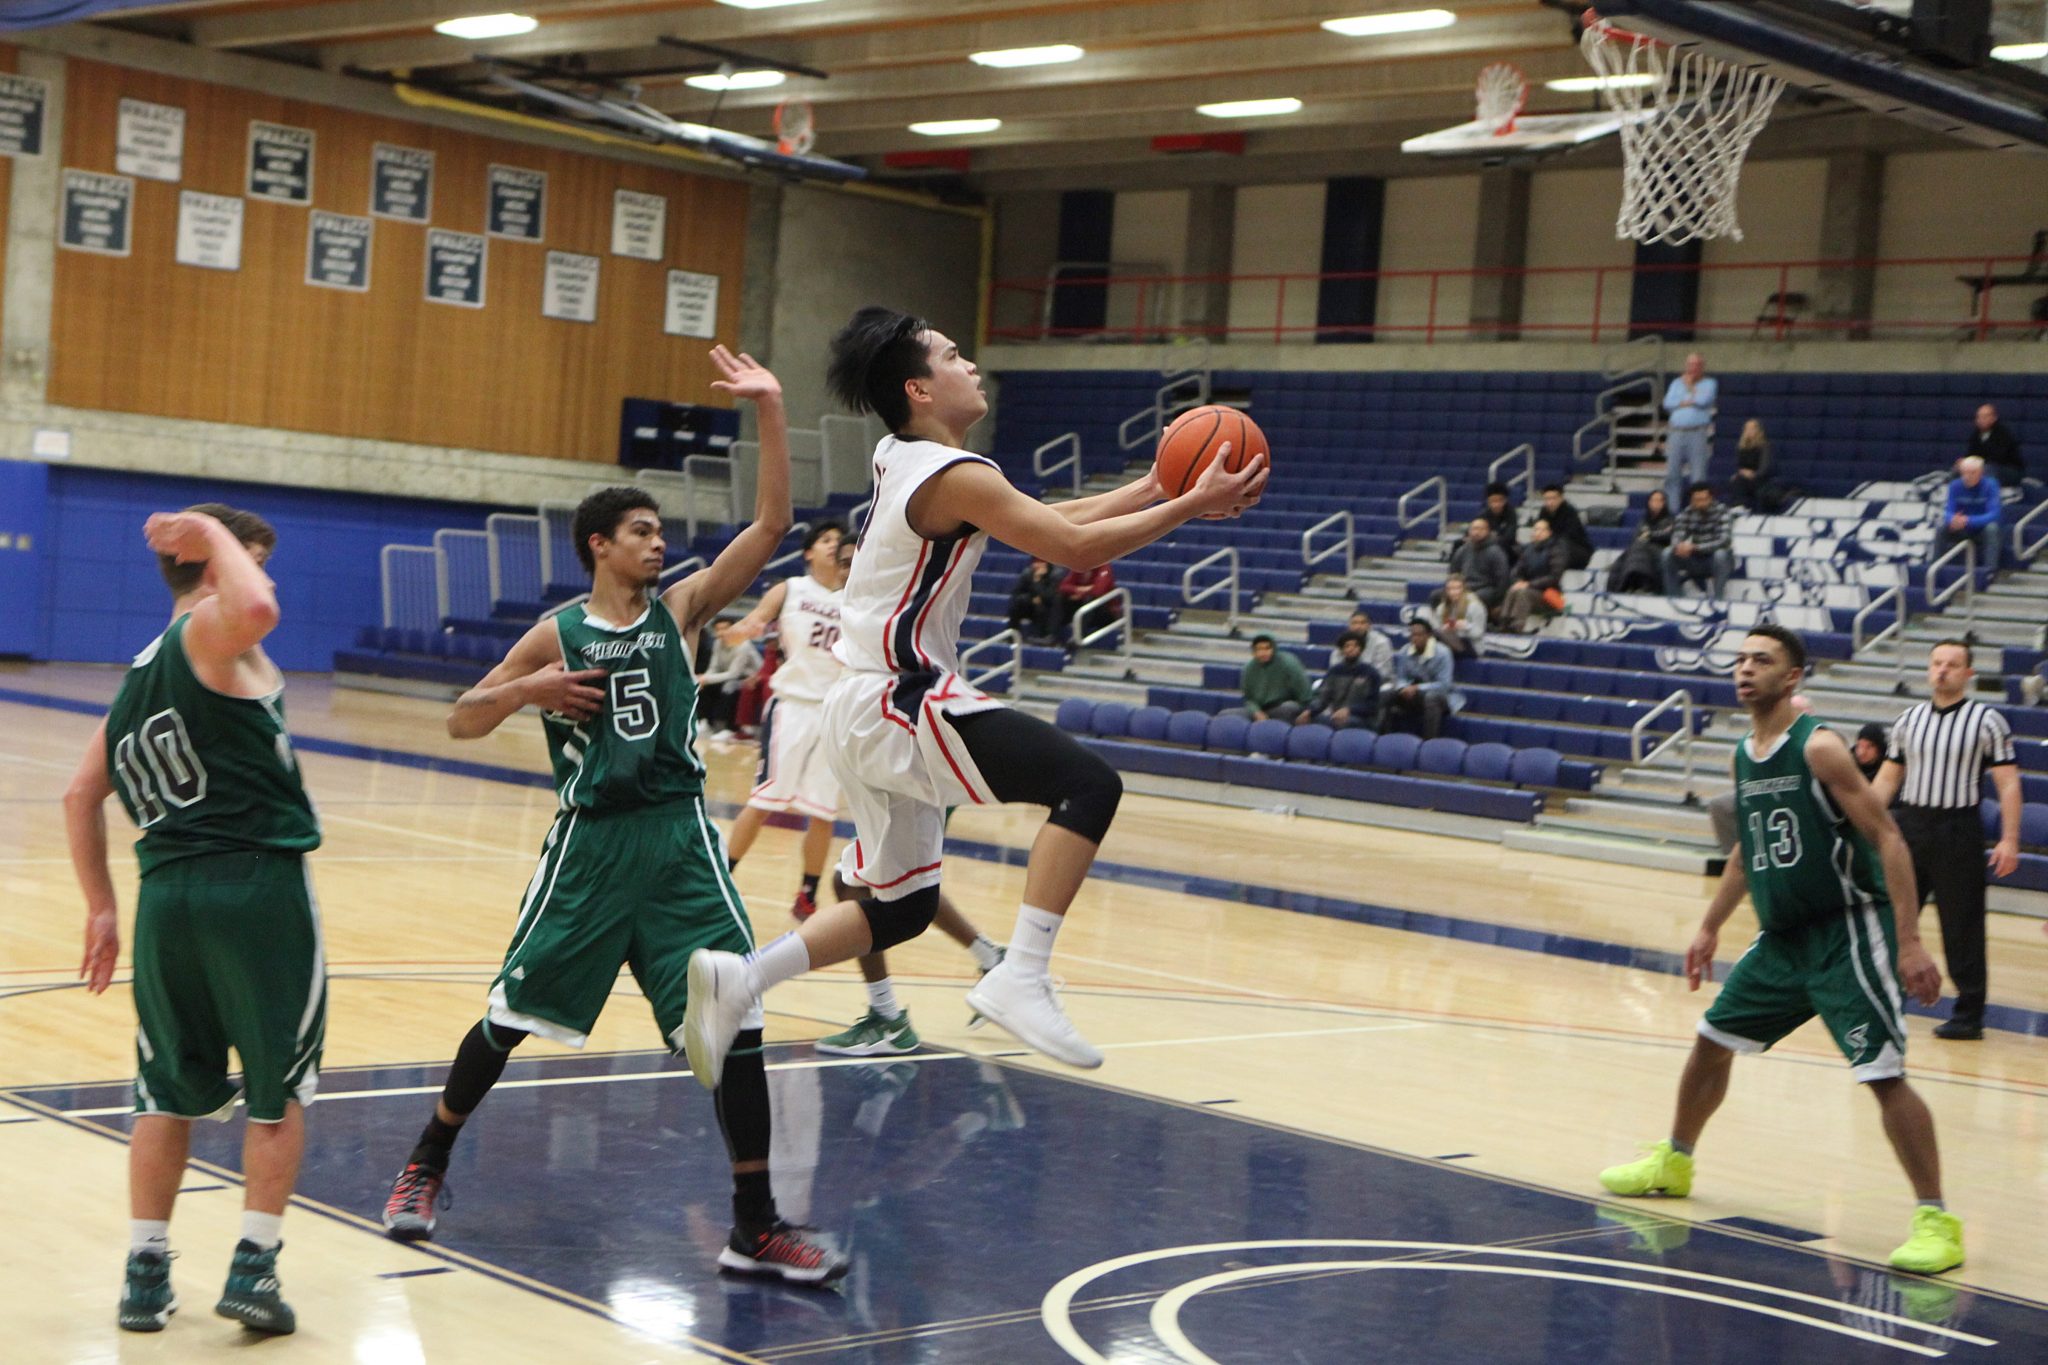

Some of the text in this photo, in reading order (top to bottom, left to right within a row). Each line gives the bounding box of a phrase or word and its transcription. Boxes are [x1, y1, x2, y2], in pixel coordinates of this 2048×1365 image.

[809, 621, 840, 652] 20
[610, 668, 660, 742] 5
[114, 706, 208, 829] 10
[1748, 807, 1803, 871] 13
